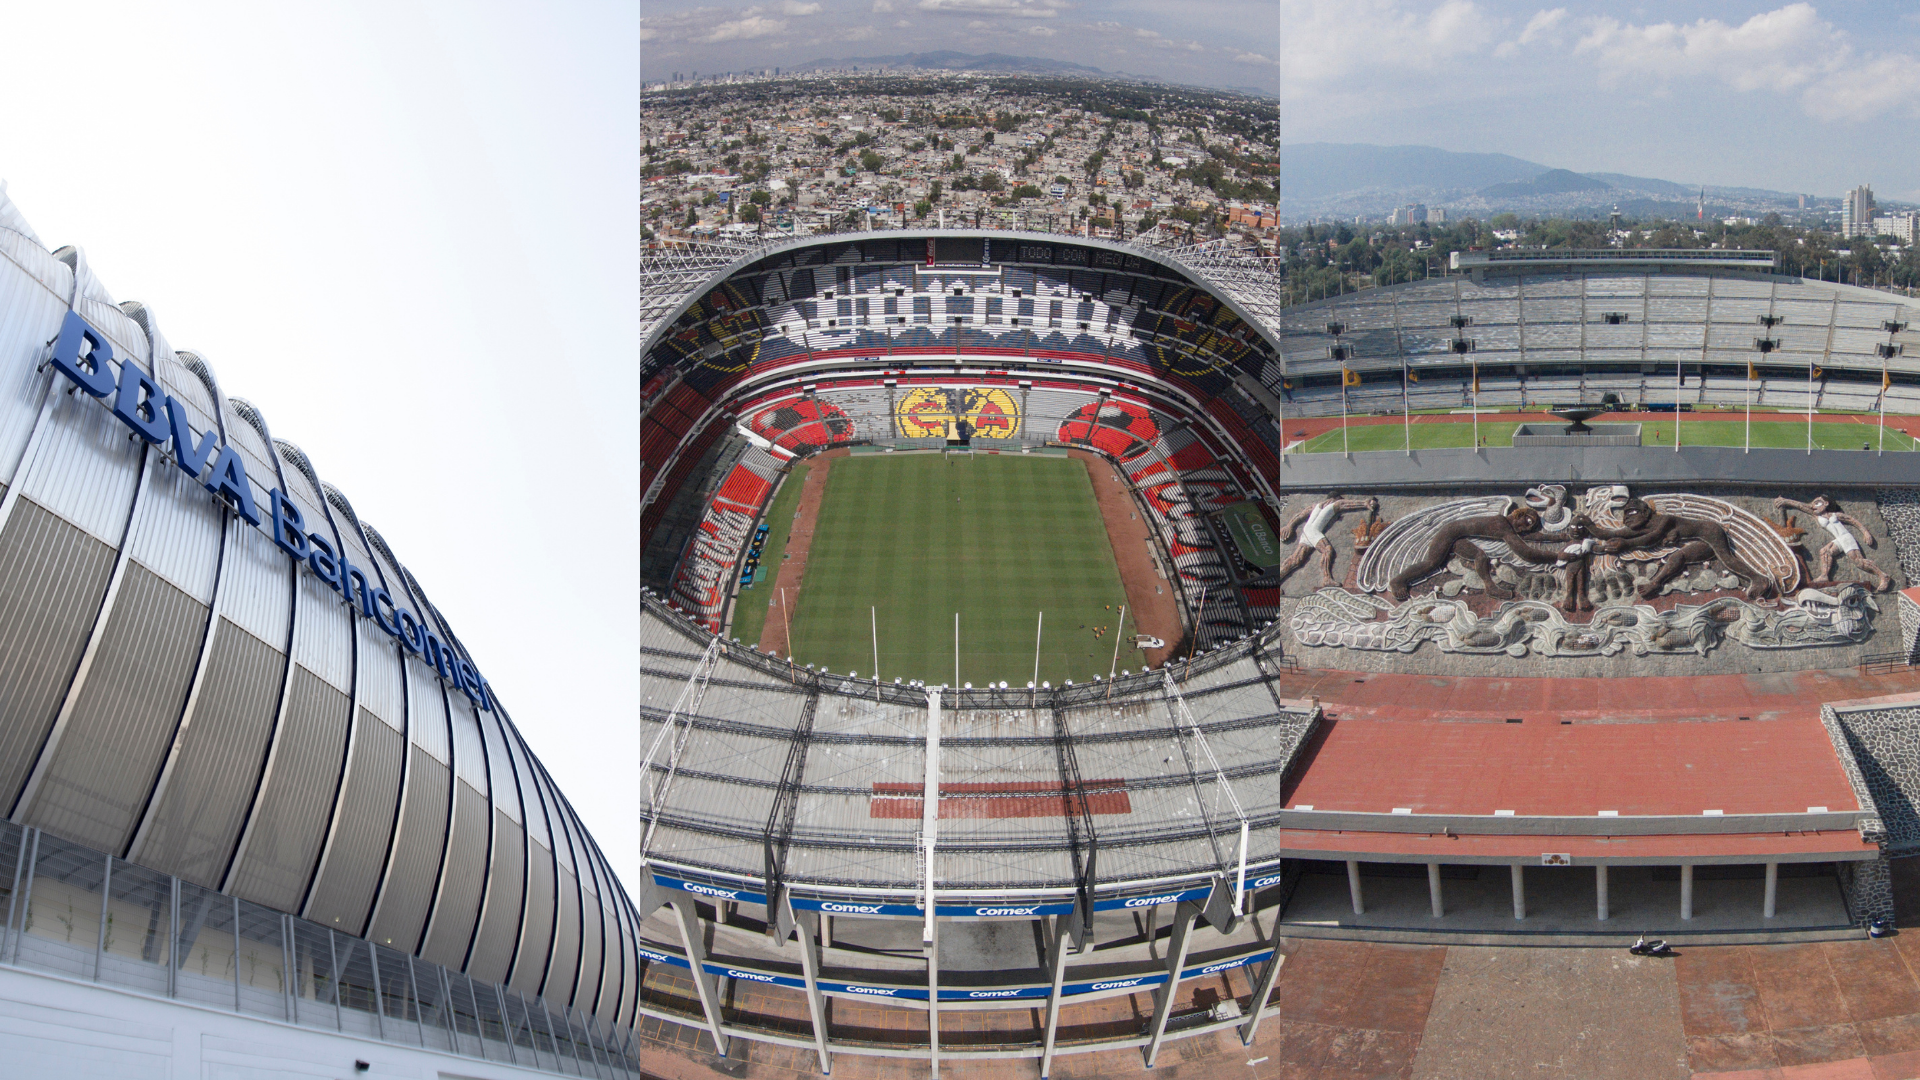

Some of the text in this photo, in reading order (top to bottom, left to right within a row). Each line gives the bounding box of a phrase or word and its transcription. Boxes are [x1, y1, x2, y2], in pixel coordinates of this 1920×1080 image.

[1021, 246, 1052, 259] TODO
[1062, 248, 1087, 261] CON
[50, 310, 491, 712] BBVA Bancomer
[683, 882, 739, 899] Comex
[1125, 891, 1186, 908] Comex
[820, 902, 884, 914] Comex
[975, 905, 1040, 916] Comex
[1202, 957, 1249, 974] Comex
[728, 970, 776, 983] Comex
[1092, 978, 1144, 990] Comex
[846, 986, 898, 996] Comex
[969, 989, 1023, 998] Comex
